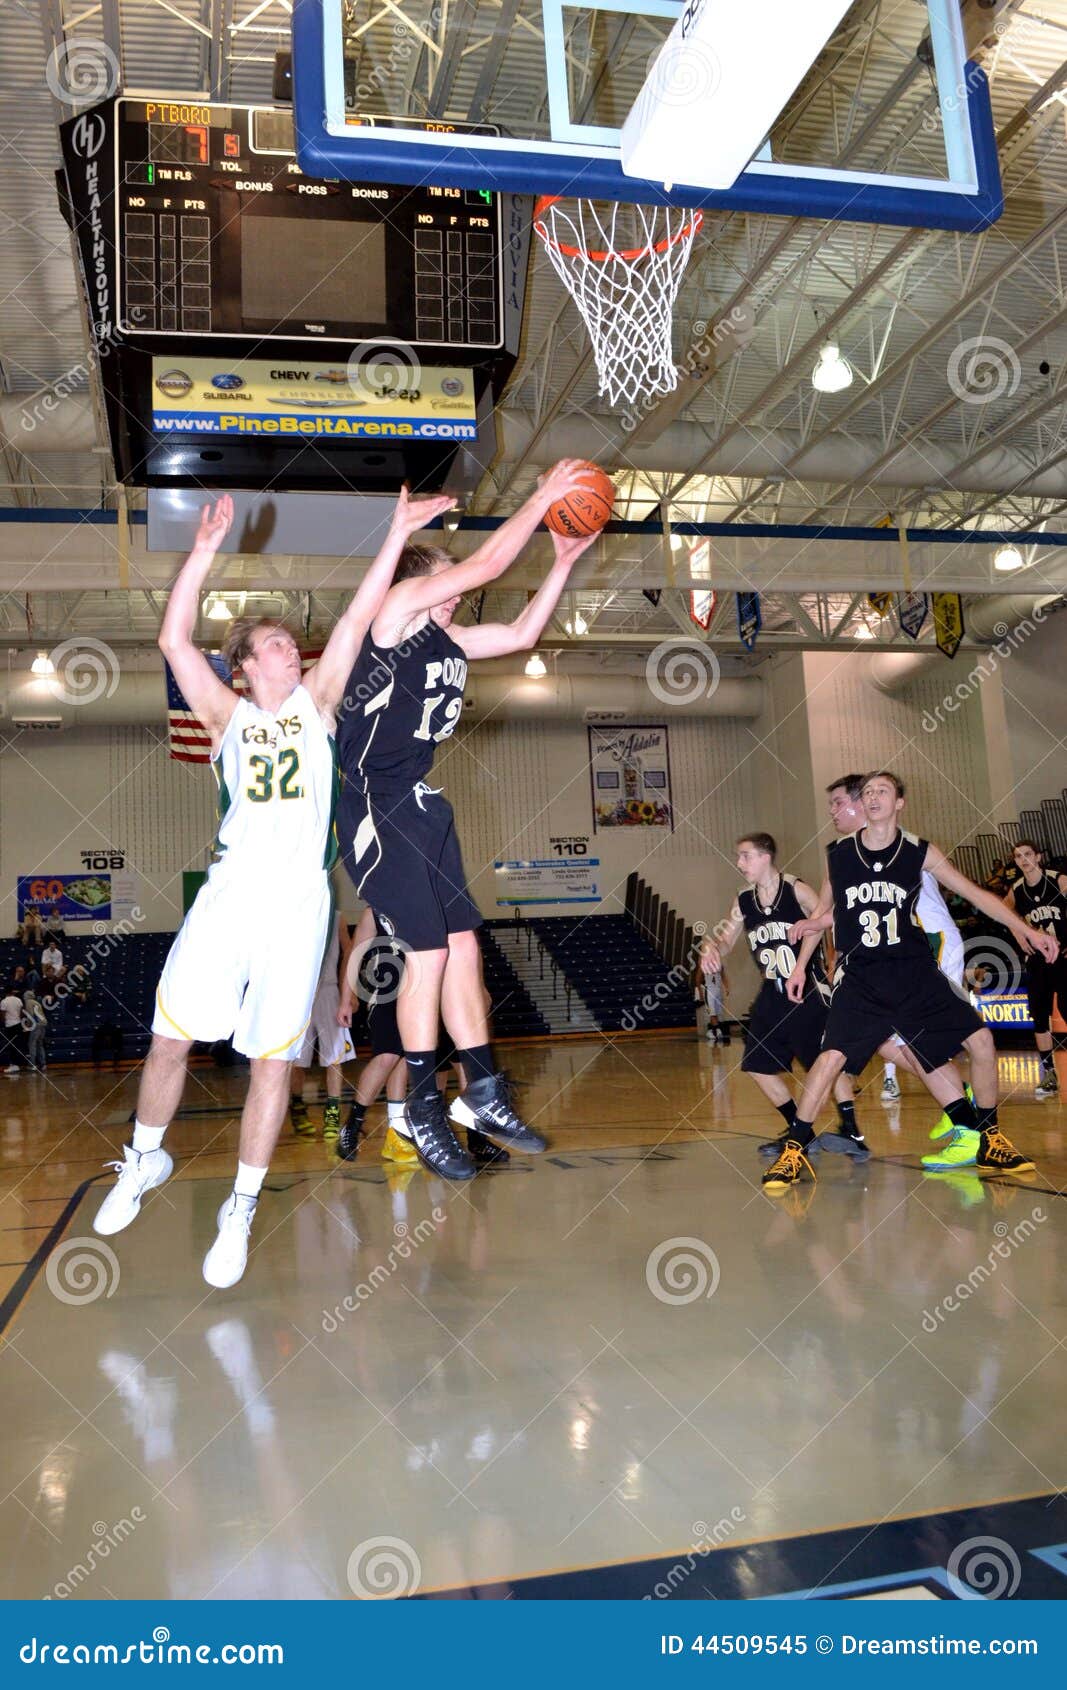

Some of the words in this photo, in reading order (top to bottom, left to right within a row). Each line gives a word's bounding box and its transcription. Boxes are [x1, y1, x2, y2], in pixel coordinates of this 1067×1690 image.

[146, 103, 211, 124] PTBORO
[221, 161, 243, 172] TOL
[158, 169, 172, 179] TM
[174, 170, 192, 181] FLS
[235, 181, 273, 192] BONUS
[298, 184, 327, 195] POSS
[429, 186, 442, 197] TM
[444, 187, 461, 198] FLS
[352, 188, 389, 199] BONUS
[129, 196, 145, 207] NO
[164, 198, 171, 208] F
[184, 200, 206, 210] PTS
[418, 214, 433, 224] NO
[450, 216, 458, 225] F
[469, 217, 489, 228] PTS
[270, 369, 310, 380] CHEVY
[203, 392, 253, 401] SUBARU
[153, 414, 476, 438] www.PineBeltArena.com
[424, 657, 468, 691] POIN
[413, 693, 463, 742] 12
[247, 747, 304, 803] 32
[553, 843, 587, 855] 110
[81, 857, 125, 870] 108
[845, 881, 907, 909] POINT
[858, 908, 901, 948] 31
[760, 944, 797, 979] 20
